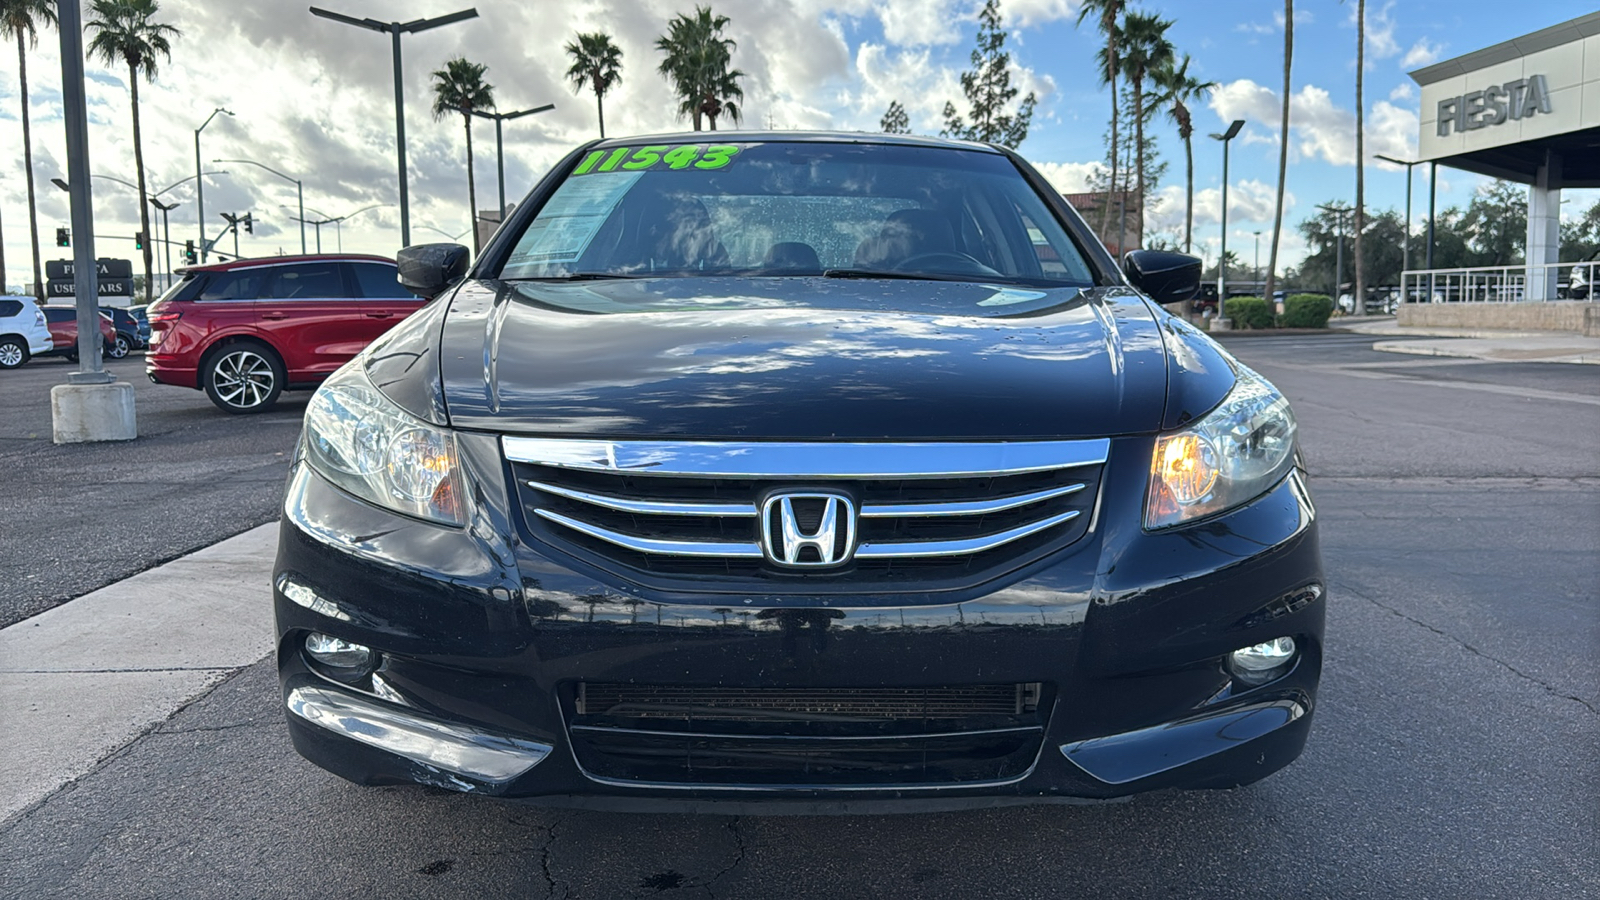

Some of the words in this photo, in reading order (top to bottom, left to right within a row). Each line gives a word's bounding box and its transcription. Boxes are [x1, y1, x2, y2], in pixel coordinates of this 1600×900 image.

[1437, 74, 1552, 137] FIESTA
[573, 145, 739, 175] 11543
[54, 283, 76, 293] USE
[98, 283, 123, 293] ARS
